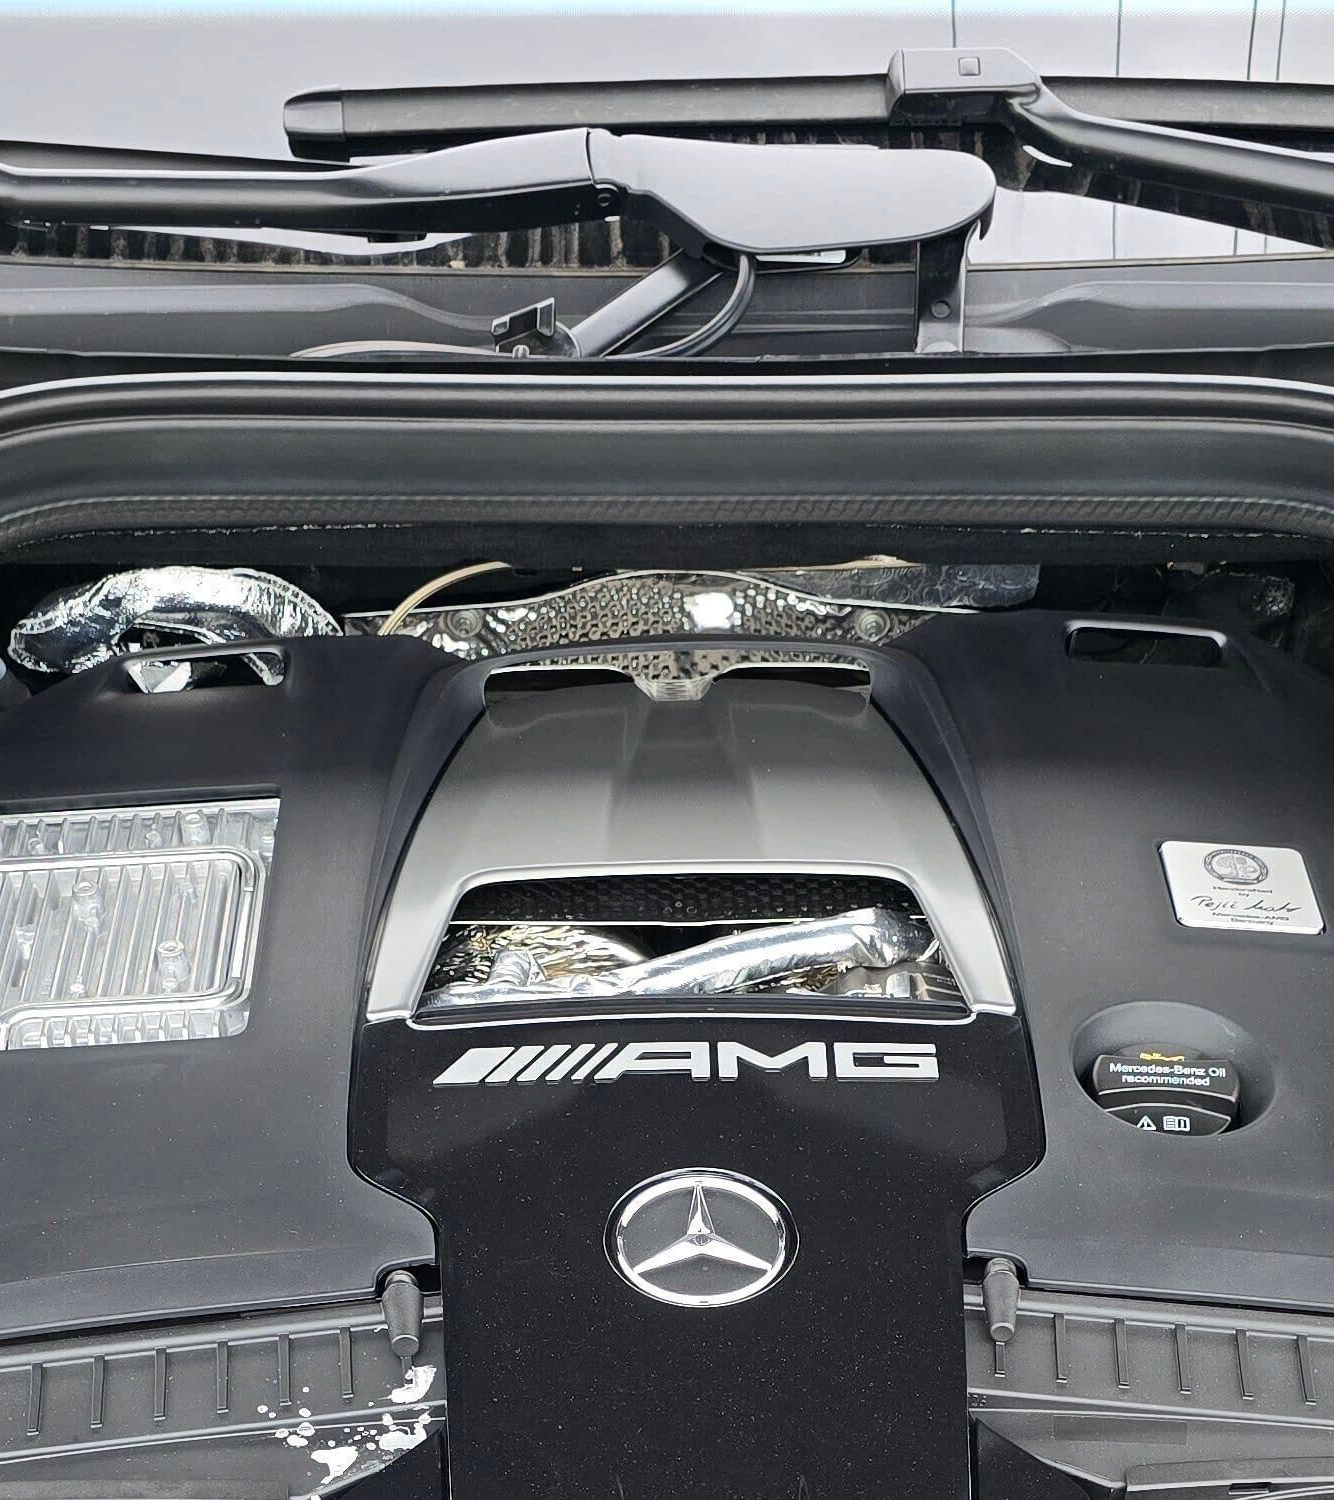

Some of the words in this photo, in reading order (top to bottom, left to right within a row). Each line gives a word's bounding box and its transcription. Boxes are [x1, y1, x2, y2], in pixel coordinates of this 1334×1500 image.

[594, 1041, 940, 1083] AMG
[1109, 1062, 1206, 1076] Mercedes-Benz
[1208, 1067, 1226, 1078] Oil
[1121, 1074, 1210, 1086] recommended
